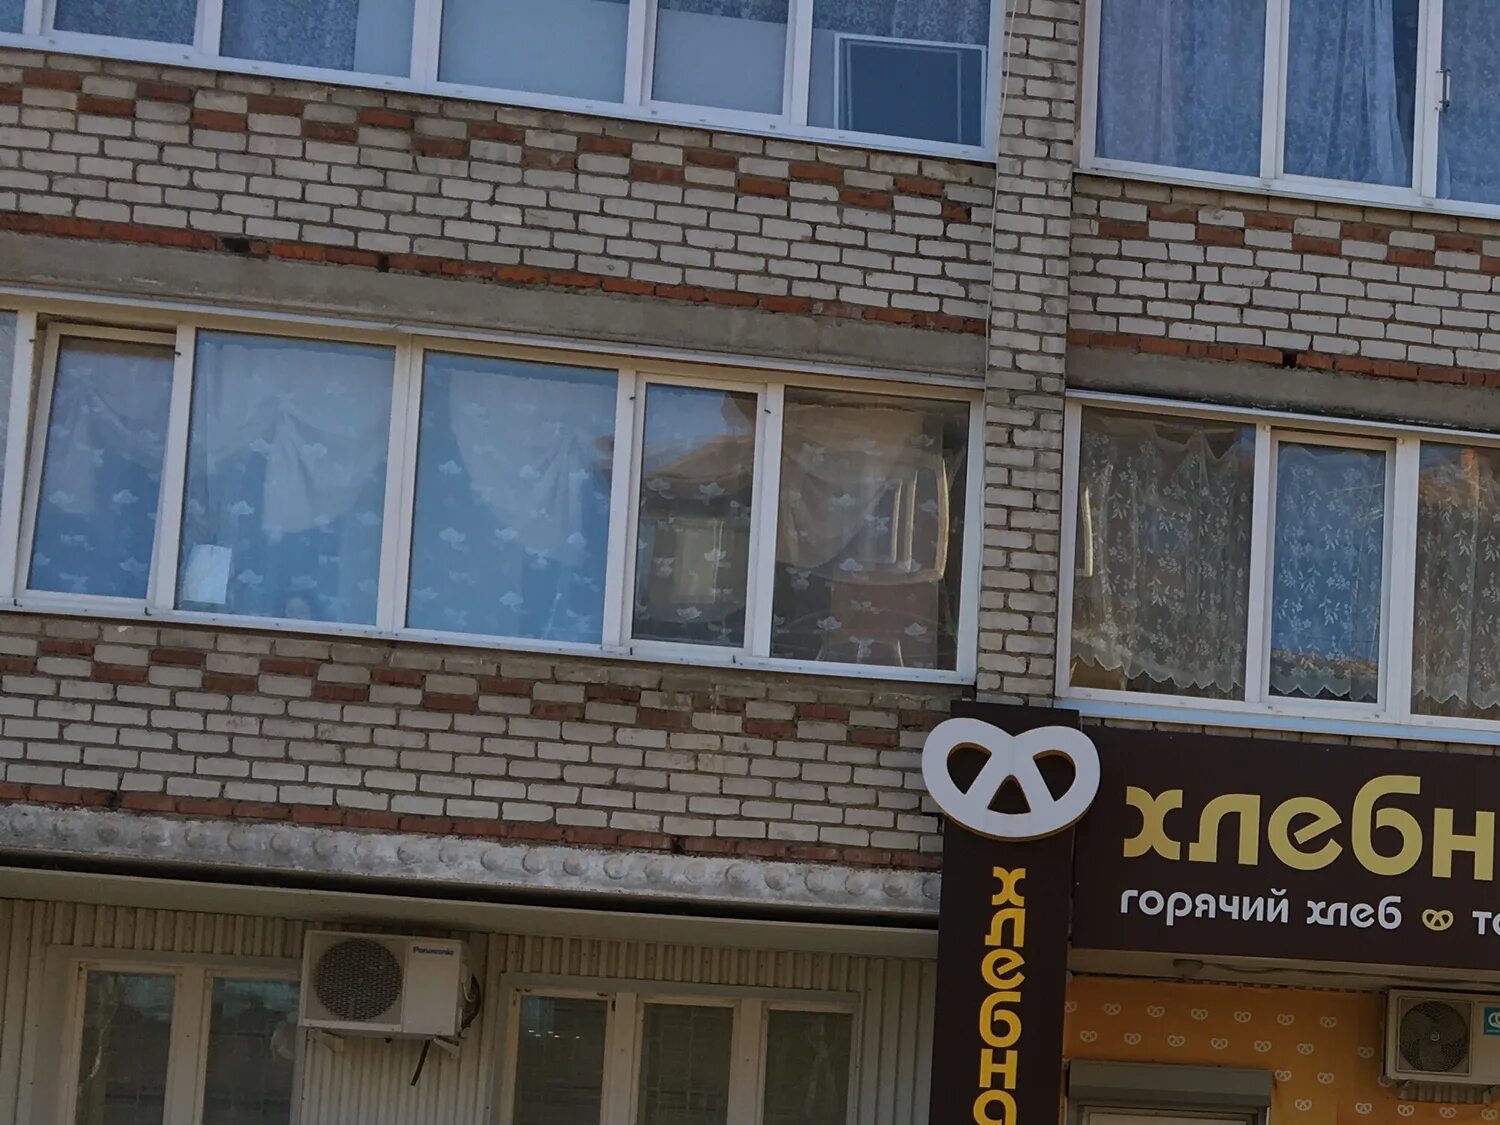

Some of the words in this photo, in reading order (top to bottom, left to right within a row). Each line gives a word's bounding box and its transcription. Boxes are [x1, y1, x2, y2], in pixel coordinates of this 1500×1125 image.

[1120, 887, 1289, 926] горячий
[1306, 895, 1403, 930] хлеб
[413, 945, 454, 956] Panasonic
